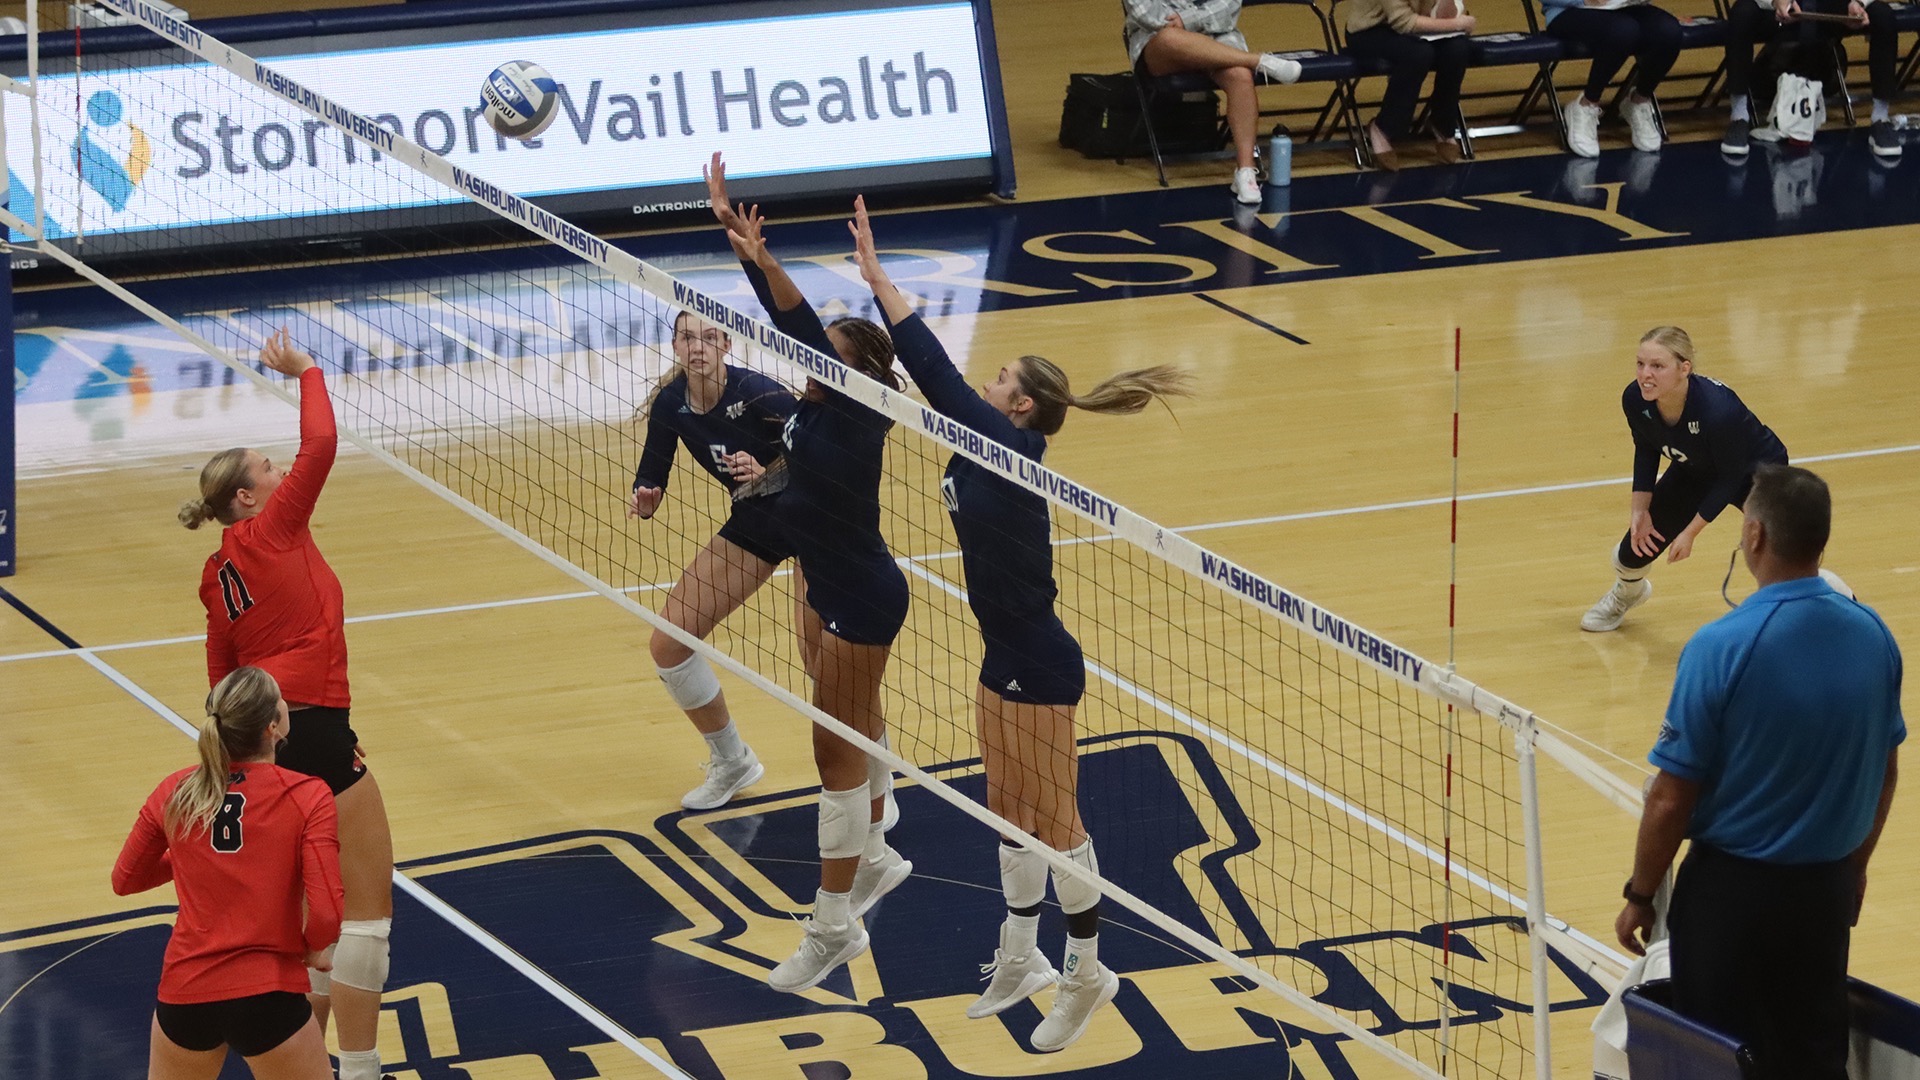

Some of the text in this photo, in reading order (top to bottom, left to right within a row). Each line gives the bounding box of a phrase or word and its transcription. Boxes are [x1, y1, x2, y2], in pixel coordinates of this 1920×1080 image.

[139, 2, 203, 50] UNIVERSITY
[171, 51, 958, 179] Stormon Vail Health
[255, 63, 395, 152] WASHBURN UNIVERSITY
[485, 85, 516, 119] molten
[453, 166, 609, 263] WASHBURN UNIVERSITY
[633, 200, 712, 214] DAKTRONICS
[673, 280, 848, 389] WASHBURN UNIVERSITY
[921, 409, 1119, 527] WASHBURN UNIVERSITY
[218, 558, 255, 623] 11
[1201, 551, 1425, 683] WASHBURN UNIVERSITY
[210, 791, 247, 853] 8
